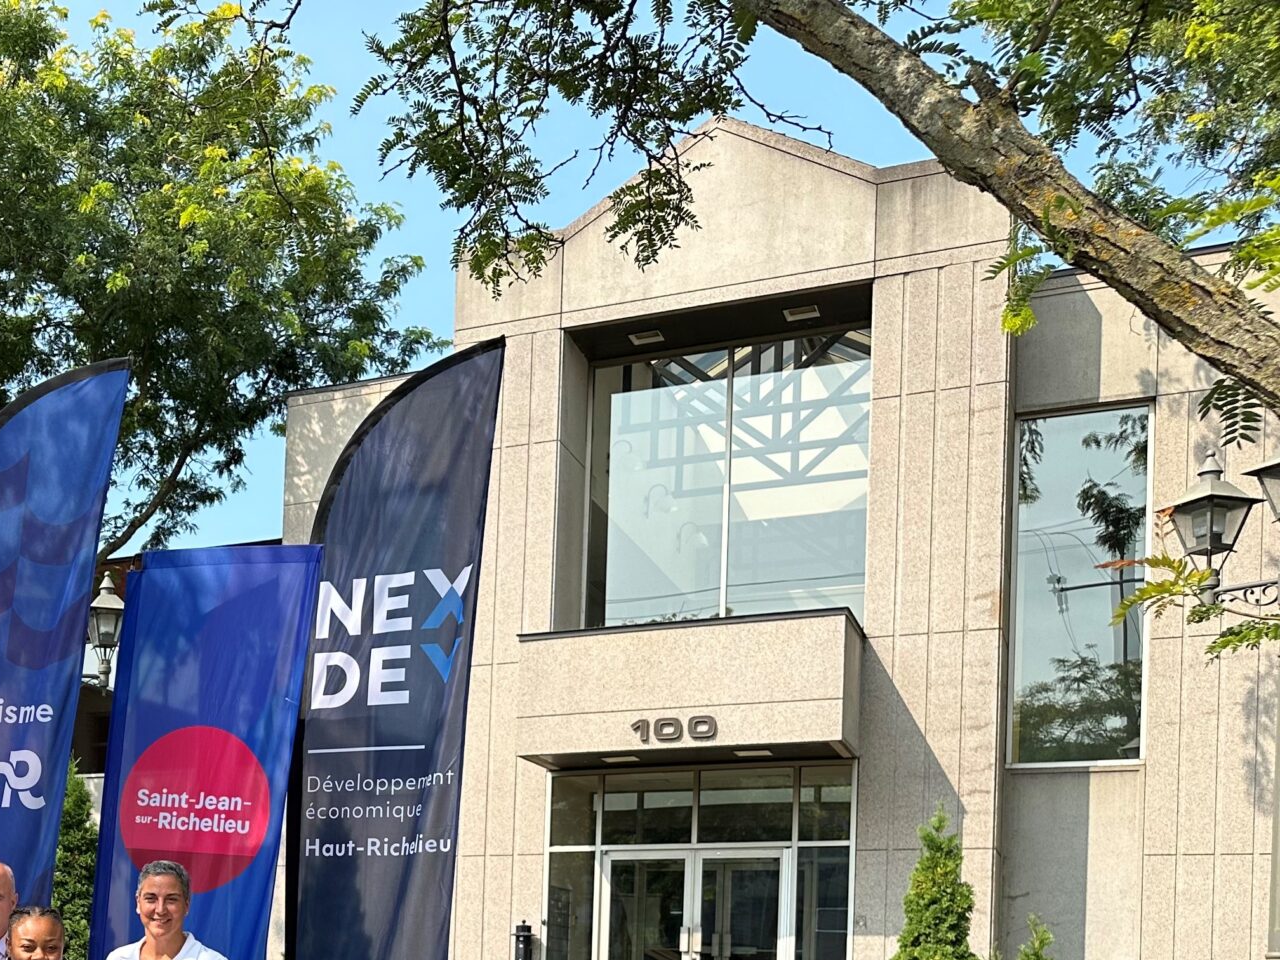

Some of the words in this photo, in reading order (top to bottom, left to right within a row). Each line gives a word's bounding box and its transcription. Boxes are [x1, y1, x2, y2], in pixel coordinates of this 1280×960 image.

[314, 563, 473, 640] NEX
[630, 715, 718, 743] 100
[307, 769, 455, 797] Développement
[136, 788, 252, 812] Saint-Jean-
[135, 811, 250, 835] sur-Richelieu
[305, 801, 422, 824] économique
[305, 834, 452, 857] Haut-Richelieu
